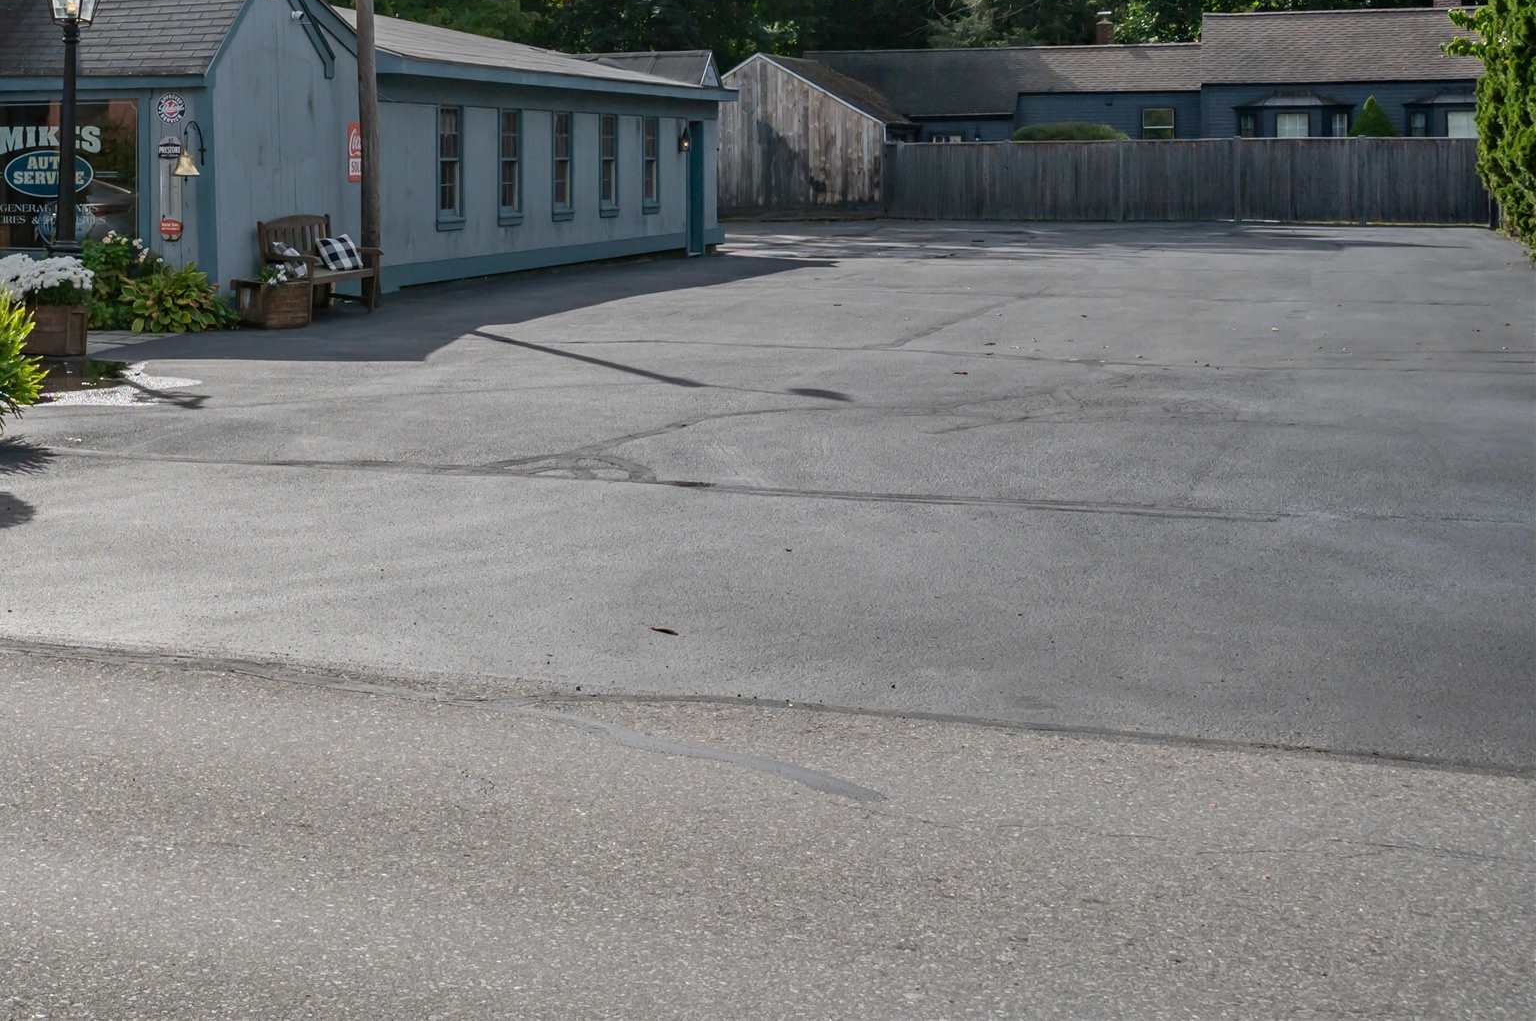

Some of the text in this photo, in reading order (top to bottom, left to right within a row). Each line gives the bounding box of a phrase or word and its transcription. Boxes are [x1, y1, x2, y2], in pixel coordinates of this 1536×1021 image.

[0, 125, 102, 155] MIKS
[27, 156, 61, 170] AUT
[13, 171, 85, 185] SERVE
